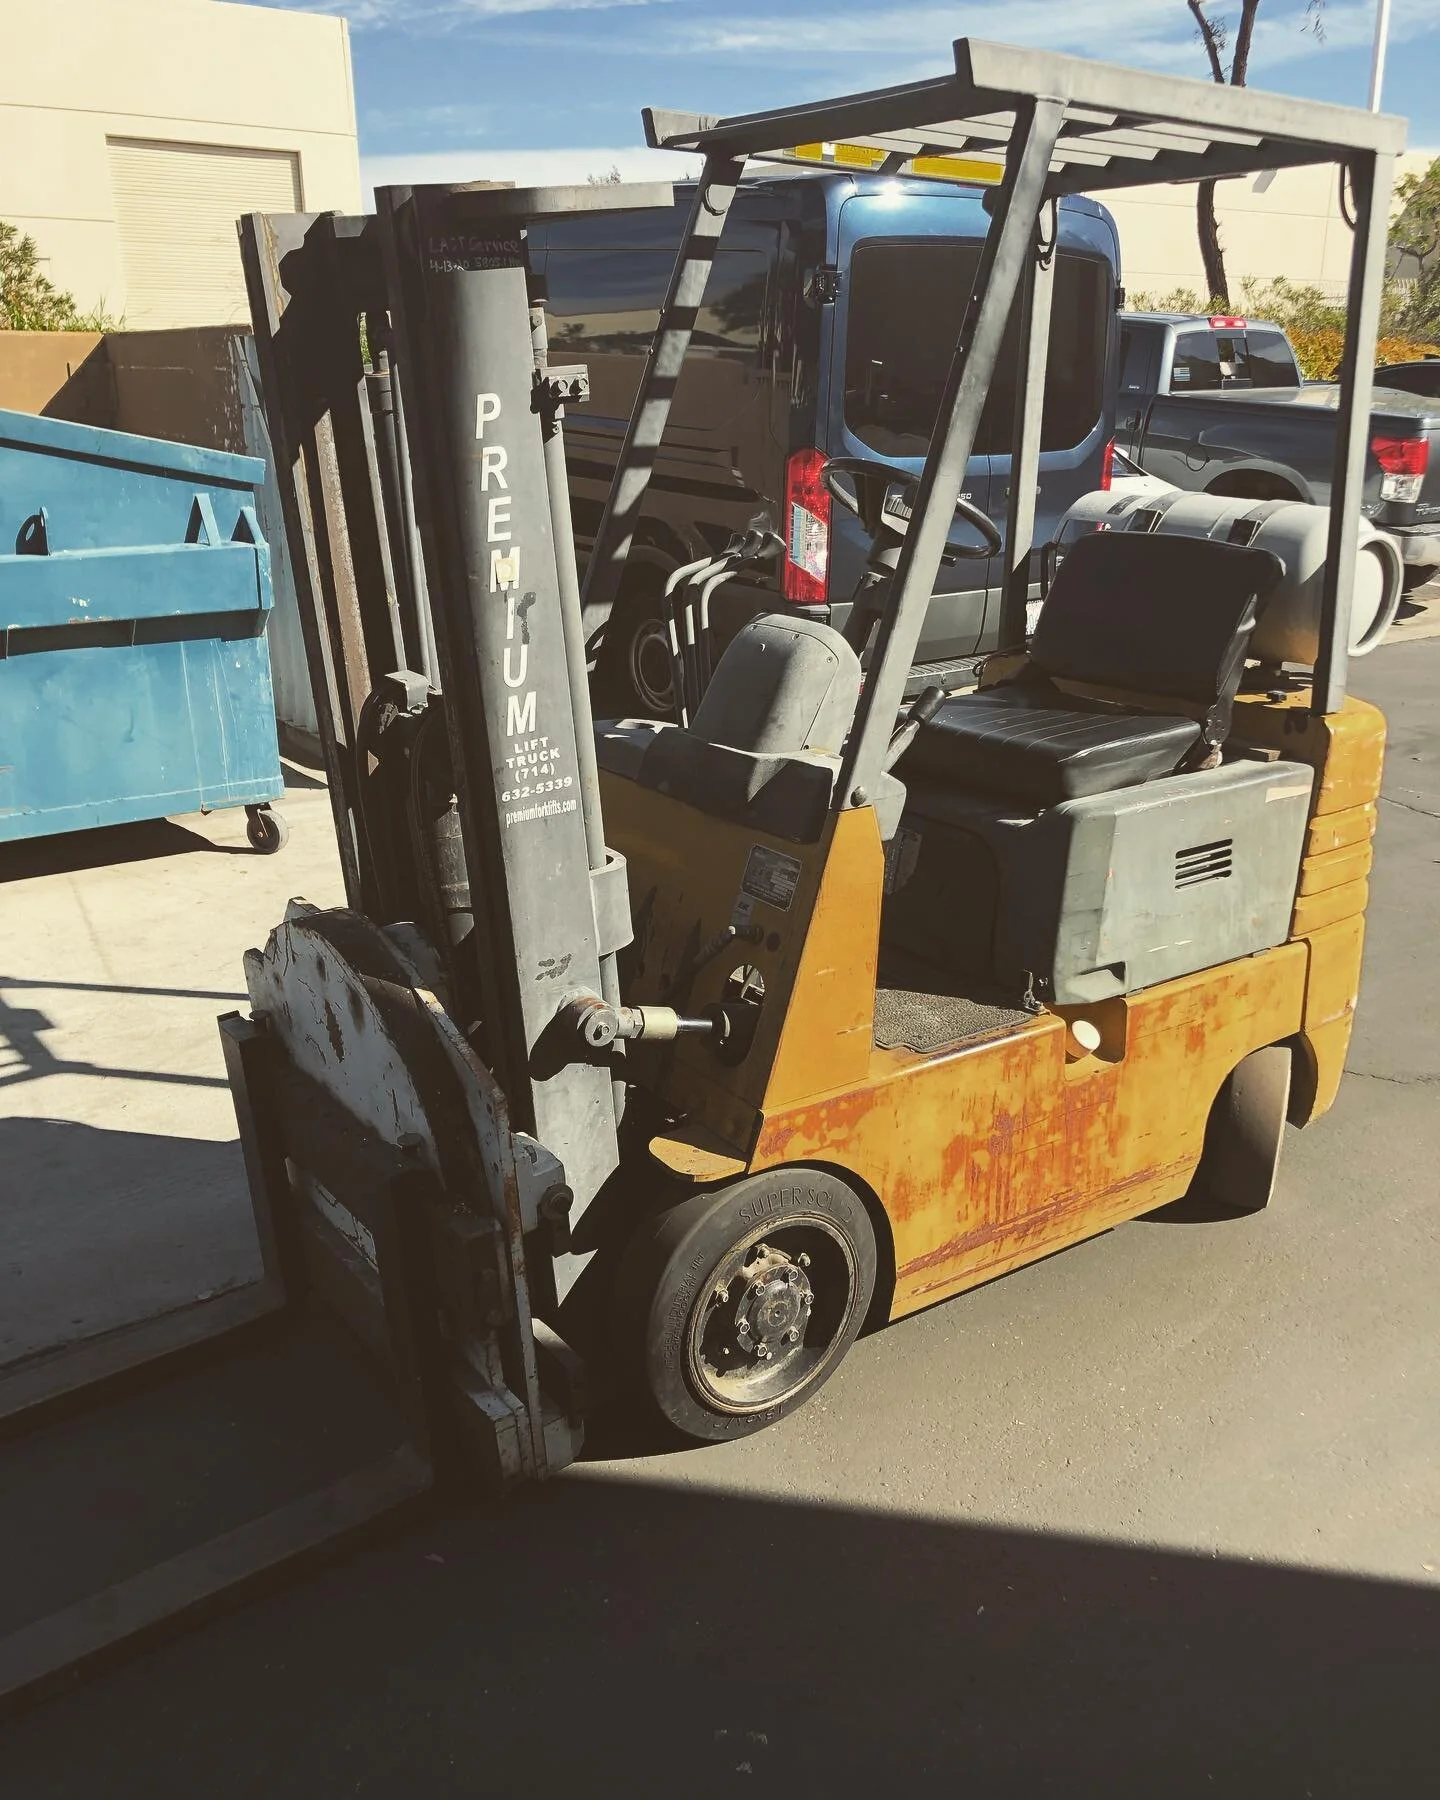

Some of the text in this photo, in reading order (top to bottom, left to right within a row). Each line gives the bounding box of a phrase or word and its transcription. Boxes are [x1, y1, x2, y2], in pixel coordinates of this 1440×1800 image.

[475, 392, 536, 737] PREMIUM
[506, 748, 560, 768] TRUCK
[514, 737, 548, 754] LIFT
[515, 762, 555, 783] (714)
[502, 776, 572, 802] 632-5339
[505, 800, 576, 828] premiumforklifts.com
[739, 1186, 803, 1225] SUPER
